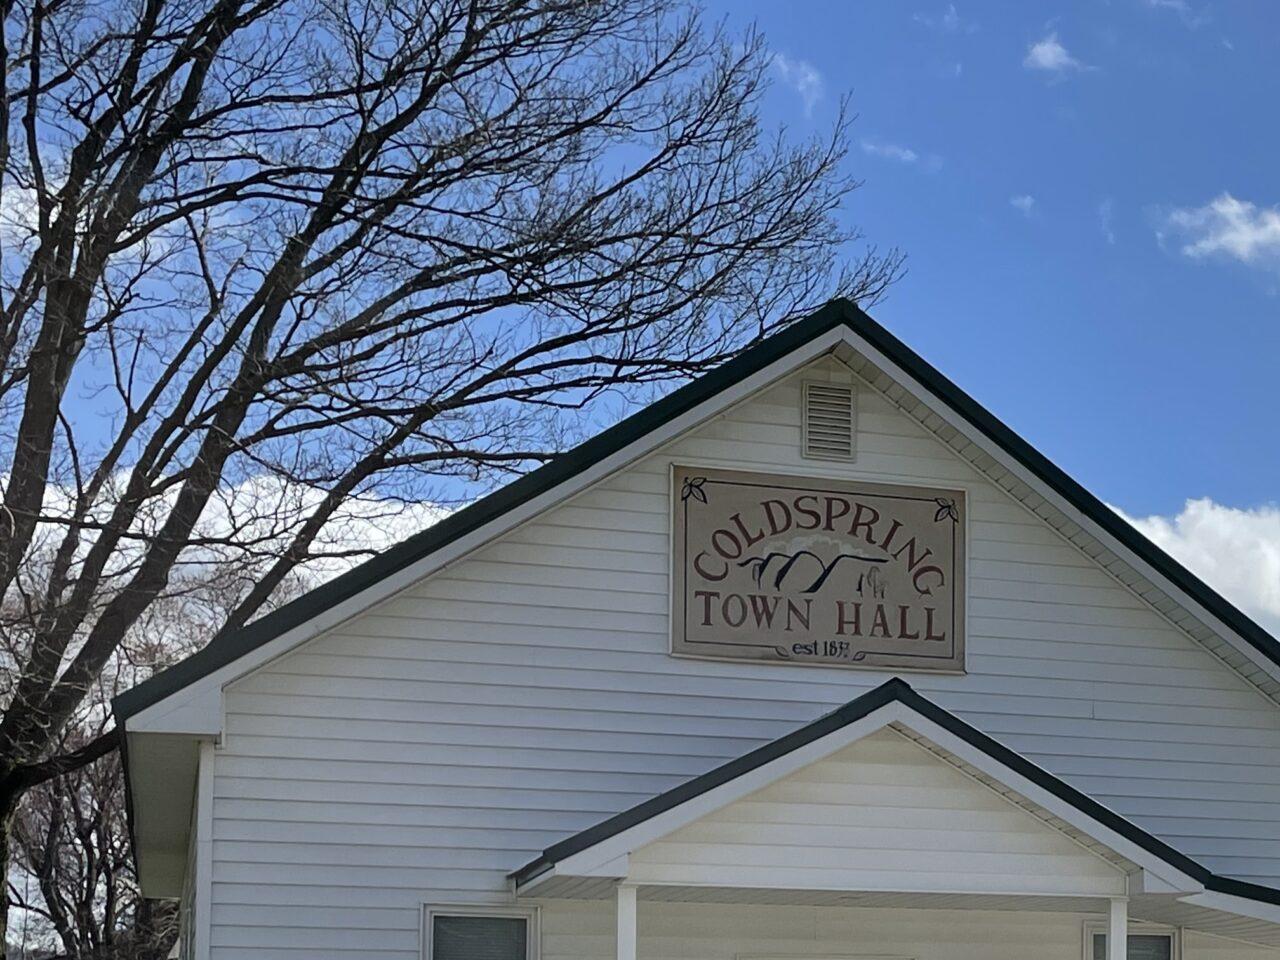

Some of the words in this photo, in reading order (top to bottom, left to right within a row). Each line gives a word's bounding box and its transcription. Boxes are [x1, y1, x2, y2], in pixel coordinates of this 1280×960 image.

[694, 495, 945, 596] COLDSPRING
[694, 591, 813, 632] TOWN
[836, 601, 945, 641] HALL
[792, 640, 818, 656] est
